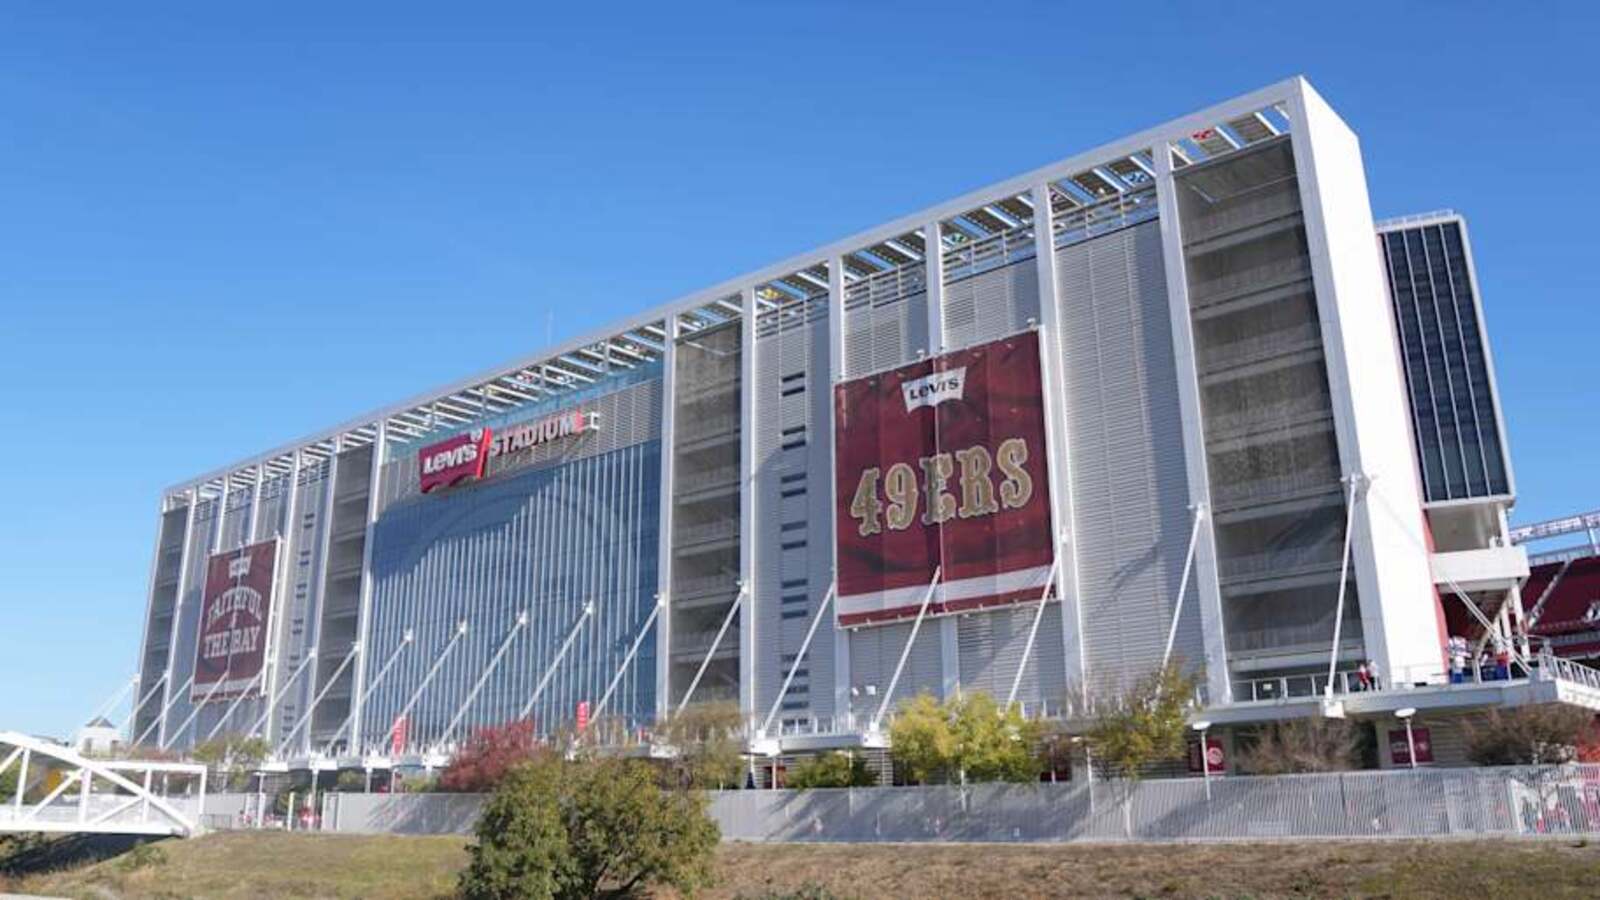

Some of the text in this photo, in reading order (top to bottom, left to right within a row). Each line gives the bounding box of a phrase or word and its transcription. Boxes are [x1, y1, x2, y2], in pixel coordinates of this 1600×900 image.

[489, 412, 577, 457] STADIUM
[850, 438, 1034, 537] 49ERS
[206, 586, 262, 632] FAITHFUL
[203, 625, 260, 659] THE BAY
